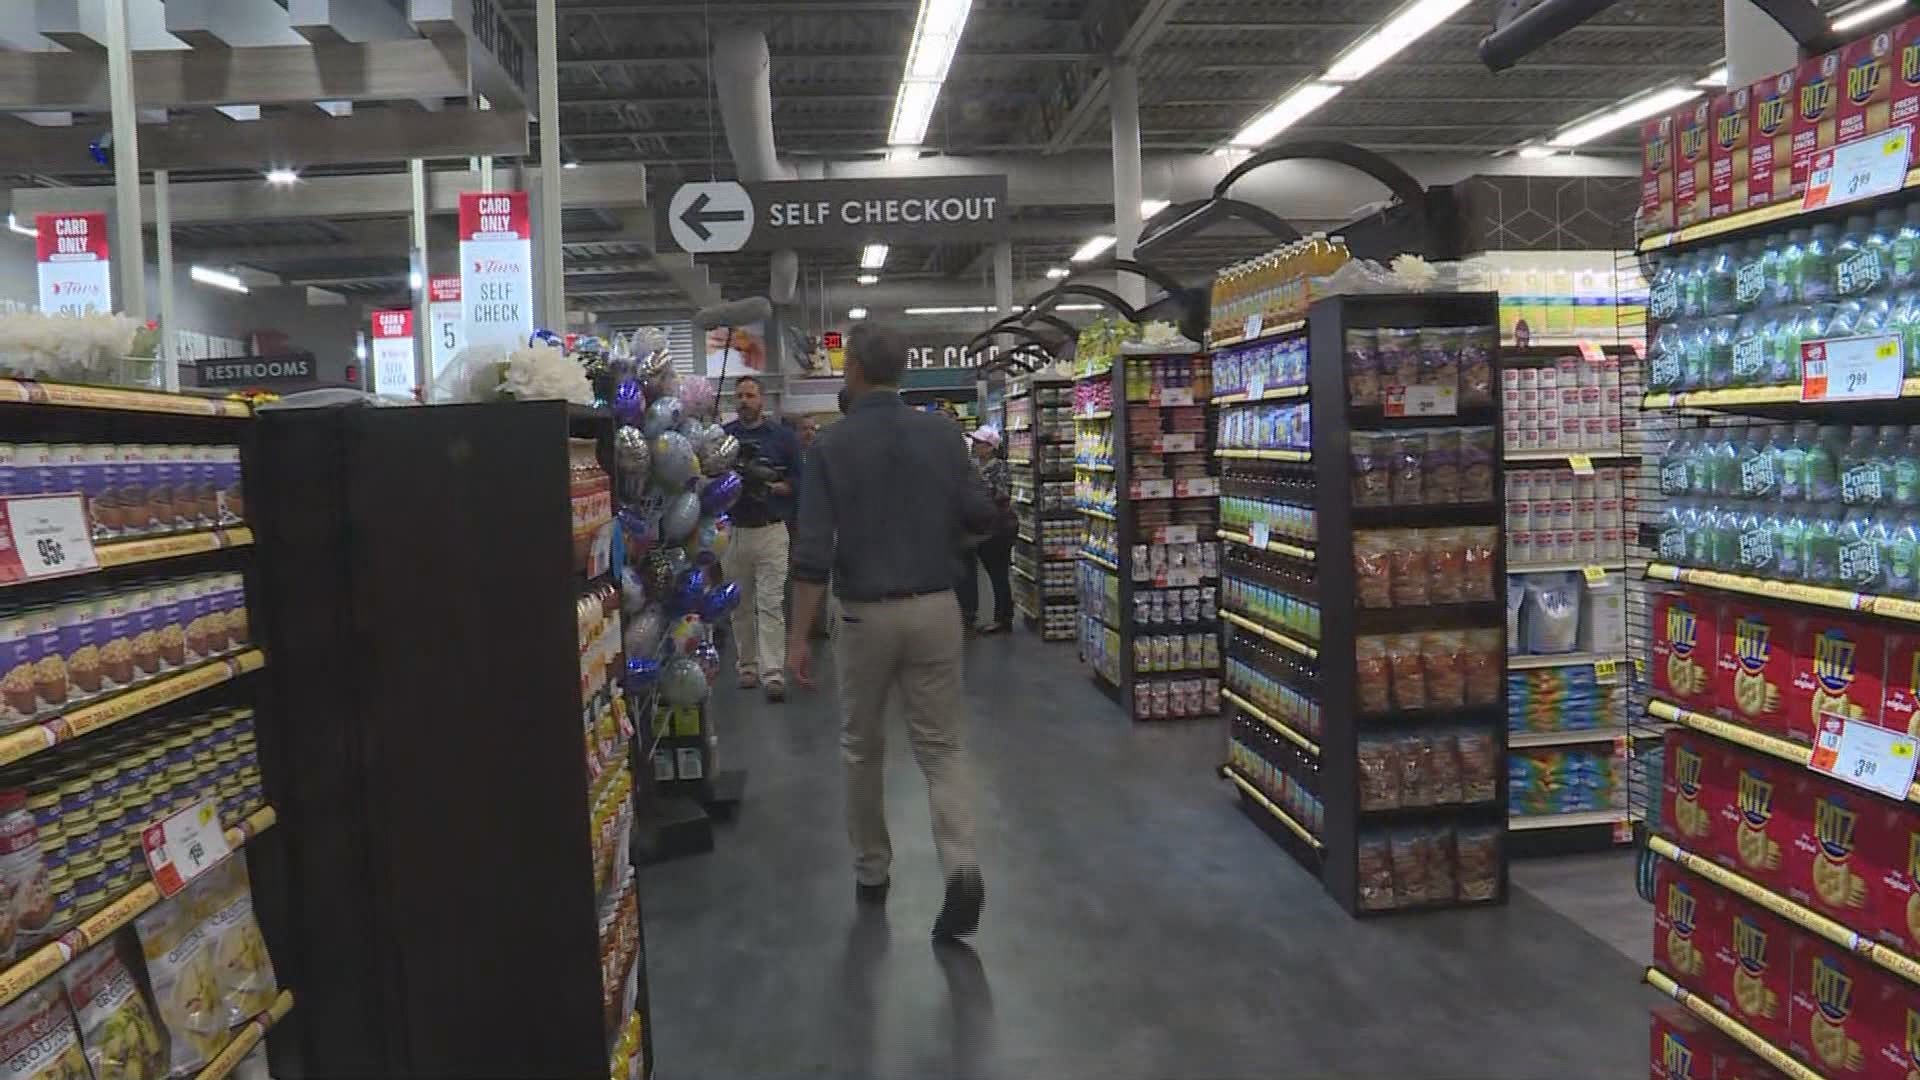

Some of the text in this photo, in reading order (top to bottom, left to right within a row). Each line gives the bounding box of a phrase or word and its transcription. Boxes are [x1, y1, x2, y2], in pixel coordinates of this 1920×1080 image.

[1848, 62, 1880, 97] RITZ
[1759, 98, 1783, 131] RITZ
[1801, 82, 1829, 115] RITZ
[1719, 113, 1741, 144] RITZ
[479, 197, 510, 214] CARD
[770, 198, 996, 226] SELF CHECKOUT
[55, 219, 88, 235] CARD
[480, 215, 510, 232] ONLY
[58, 237, 87, 252] ONLY
[480, 282, 512, 301] SELF
[474, 303, 520, 322] CHECK
[444, 323, 455, 349] 5
[206, 361, 309, 380] RESTROOMS
[1667, 607, 1696, 646] RITZ
[1735, 619, 1771, 661] RITZ
[1814, 633, 1856, 681] RITZ
[1675, 746, 1702, 789] RITZ
[1738, 770, 1772, 818] RITZ
[1814, 799, 1856, 851] RITZ
[1668, 883, 1696, 929] RITZ
[1733, 916, 1768, 967] RITZ
[1813, 957, 1853, 1015] RITZ
[1663, 1032, 1694, 1080] RITZ
